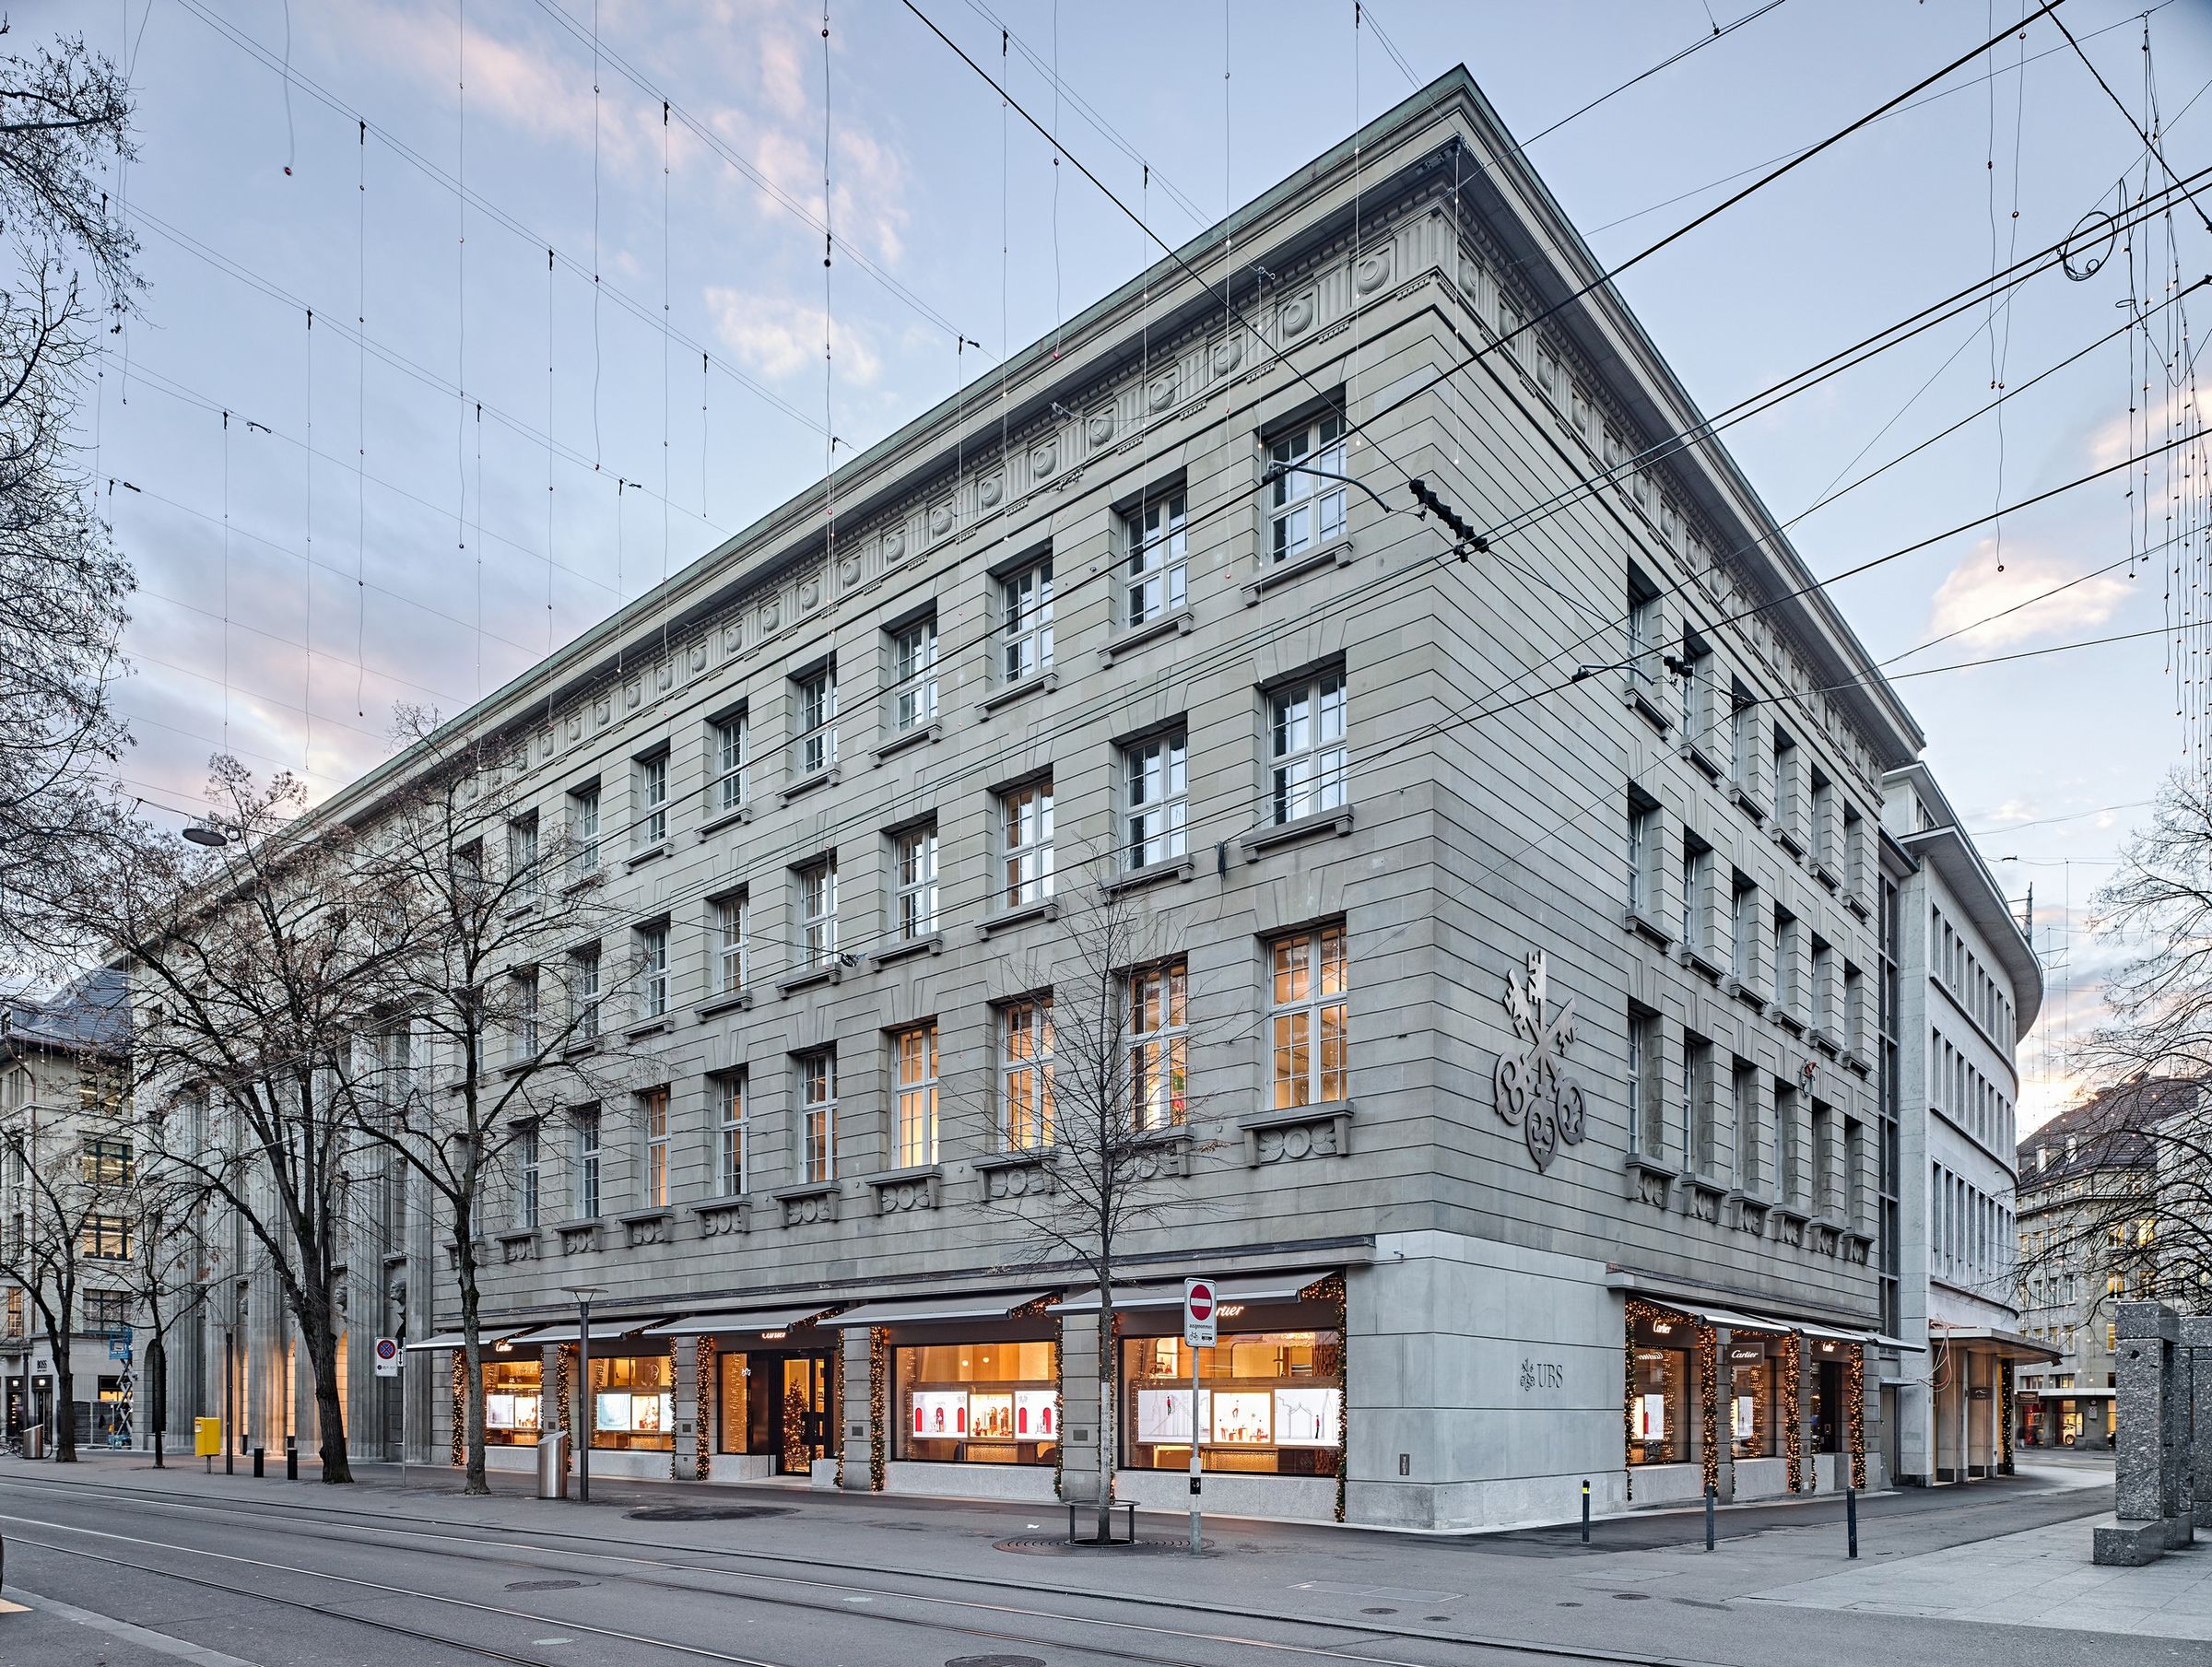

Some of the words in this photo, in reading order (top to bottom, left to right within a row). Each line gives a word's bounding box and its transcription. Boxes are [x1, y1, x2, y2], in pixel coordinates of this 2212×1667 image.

[1216, 1305, 1244, 1317] rtier
[1732, 1349, 1759, 1358] Cartier
[37, 1359, 47, 1369] BOSS
[1536, 1363, 1563, 1388] UBS
